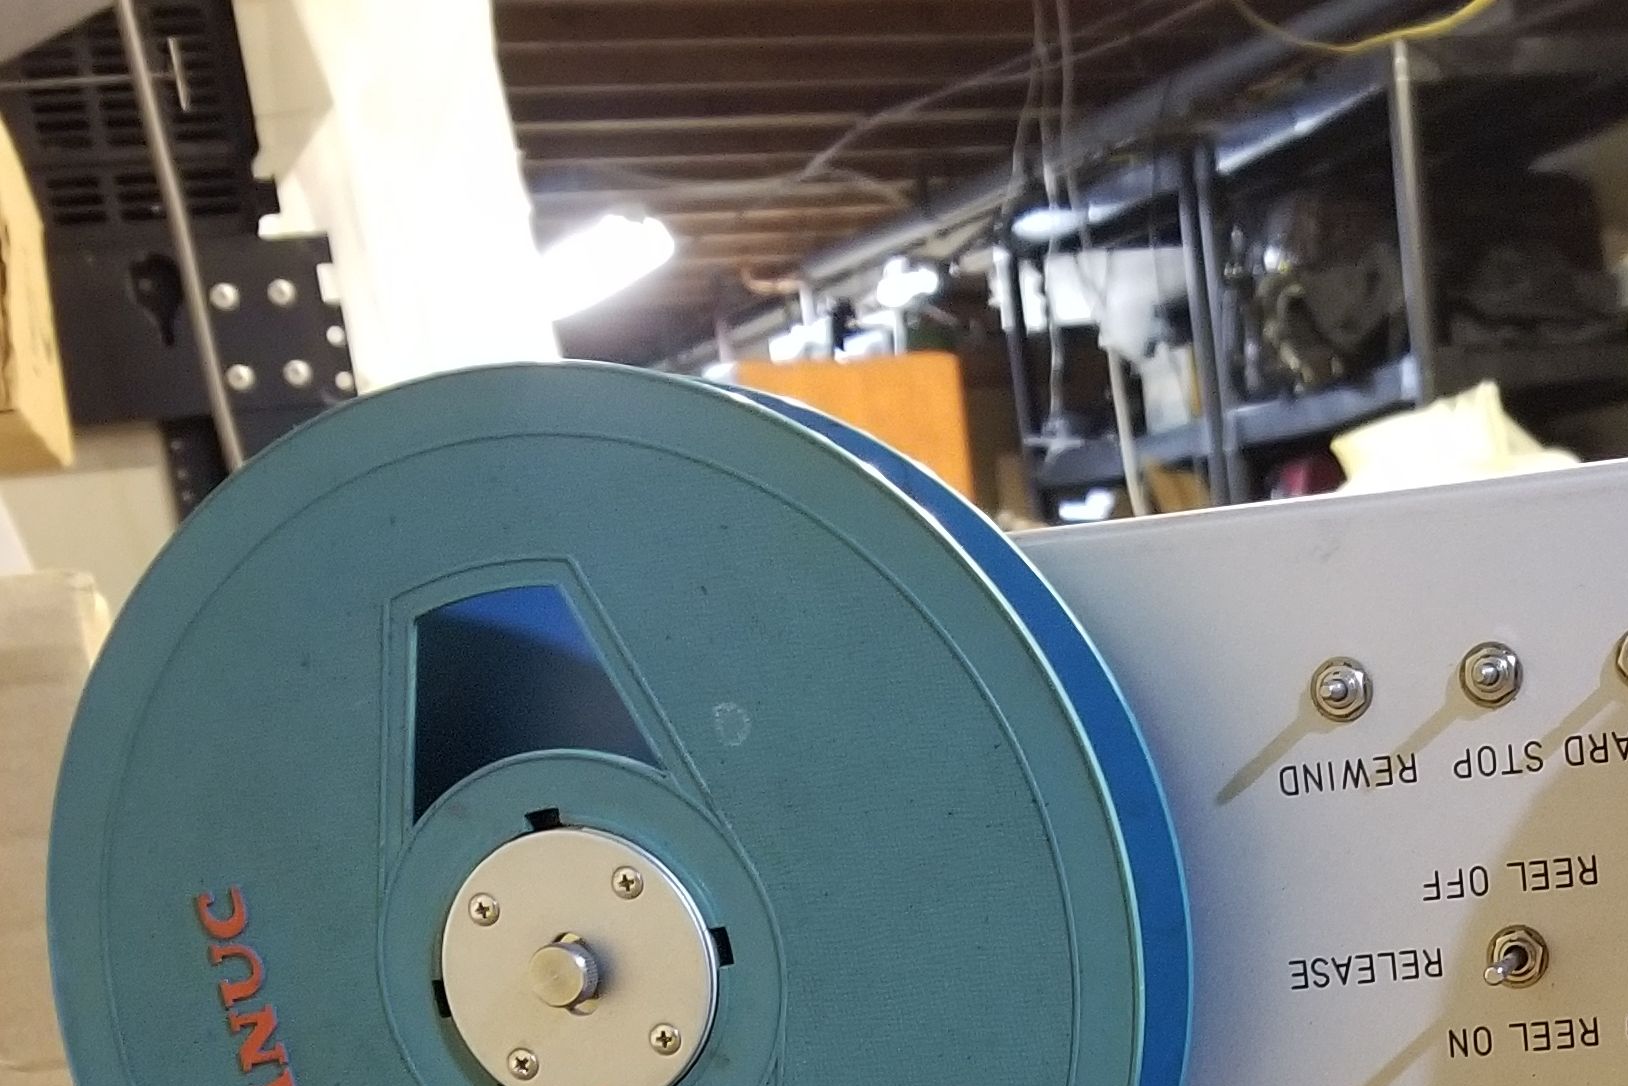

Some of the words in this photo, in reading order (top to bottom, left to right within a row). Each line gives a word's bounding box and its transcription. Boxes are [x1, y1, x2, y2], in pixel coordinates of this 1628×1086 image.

[1279, 752, 1418, 796] REWIND
[1453, 740, 1544, 779] STOP
[1422, 865, 1490, 902] OFF
[1506, 854, 1600, 892] REEL
[1288, 947, 1444, 990] RELEASE
[1447, 1026, 1494, 1059] ON
[1509, 1016, 1600, 1052] REEL
